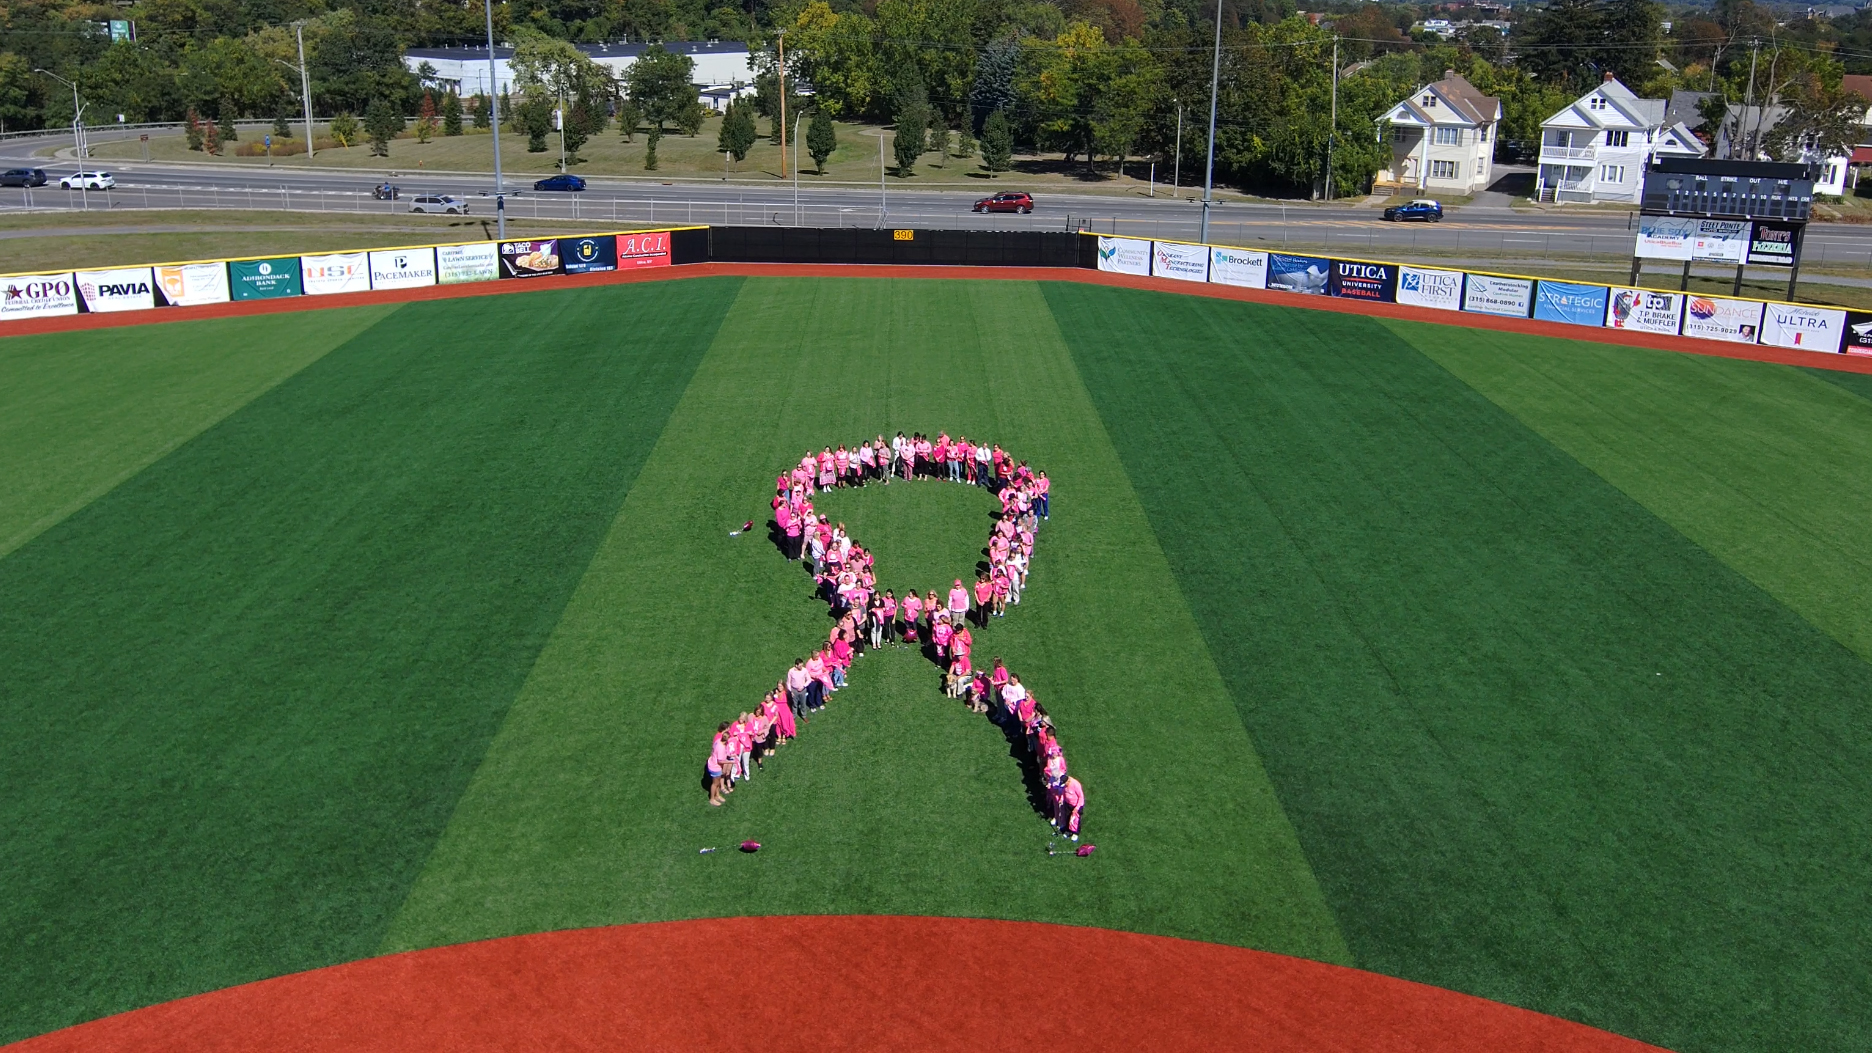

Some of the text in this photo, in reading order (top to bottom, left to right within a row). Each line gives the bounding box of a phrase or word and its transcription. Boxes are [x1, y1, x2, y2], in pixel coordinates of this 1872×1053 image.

[1720, 221, 1741, 230] PONTE
[894, 230, 913, 240] 390
[623, 237, 666, 254] A.C.I.
[1228, 255, 1263, 267] Brockett
[242, 273, 290, 282] ADIRONDACK
[374, 269, 433, 281] PACEMAKER
[1339, 263, 1387, 280] UTICA
[1342, 280, 1382, 289] UNIVERSITY
[1421, 273, 1458, 287] UTICA
[25, 280, 70, 299] GPO
[98, 282, 150, 297] PAVIA
[1341, 288, 1380, 298] BASEBALL
[1421, 285, 1456, 297] FIRST
[1468, 295, 1485, 303] (315)
[1538, 292, 1603, 308] STRATEGIC
[1571, 306, 1595, 314] SERVICES
[1652, 311, 1677, 320] BRAKE
[1690, 304, 1758, 319] SUNDANCE
[1643, 318, 1677, 328] MUFFLER
[1686, 323, 1704, 331] (315)
[1776, 314, 1828, 329] ULTRA
